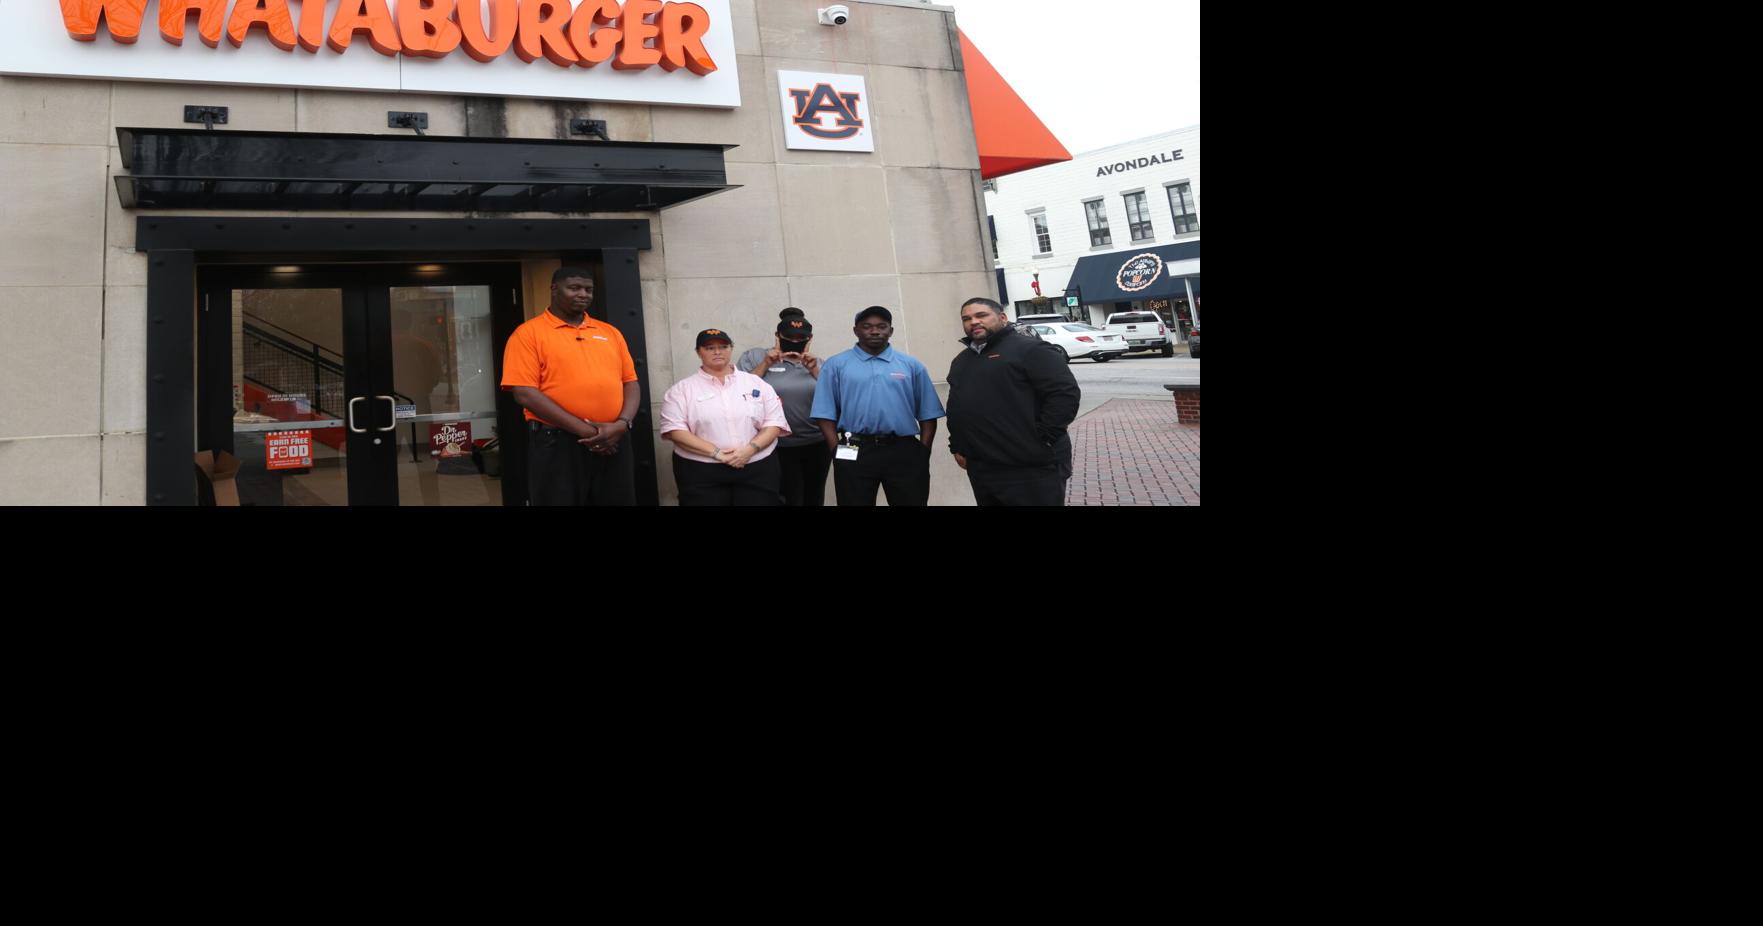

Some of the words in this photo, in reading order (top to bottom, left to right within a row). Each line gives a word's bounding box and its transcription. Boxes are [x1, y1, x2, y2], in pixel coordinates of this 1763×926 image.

[59, 0, 719, 77] WHATABURGER
[1096, 149, 1184, 177] AVONDALE
[1123, 268, 1156, 278] POPCORN
[433, 430, 467, 446] Pepper
